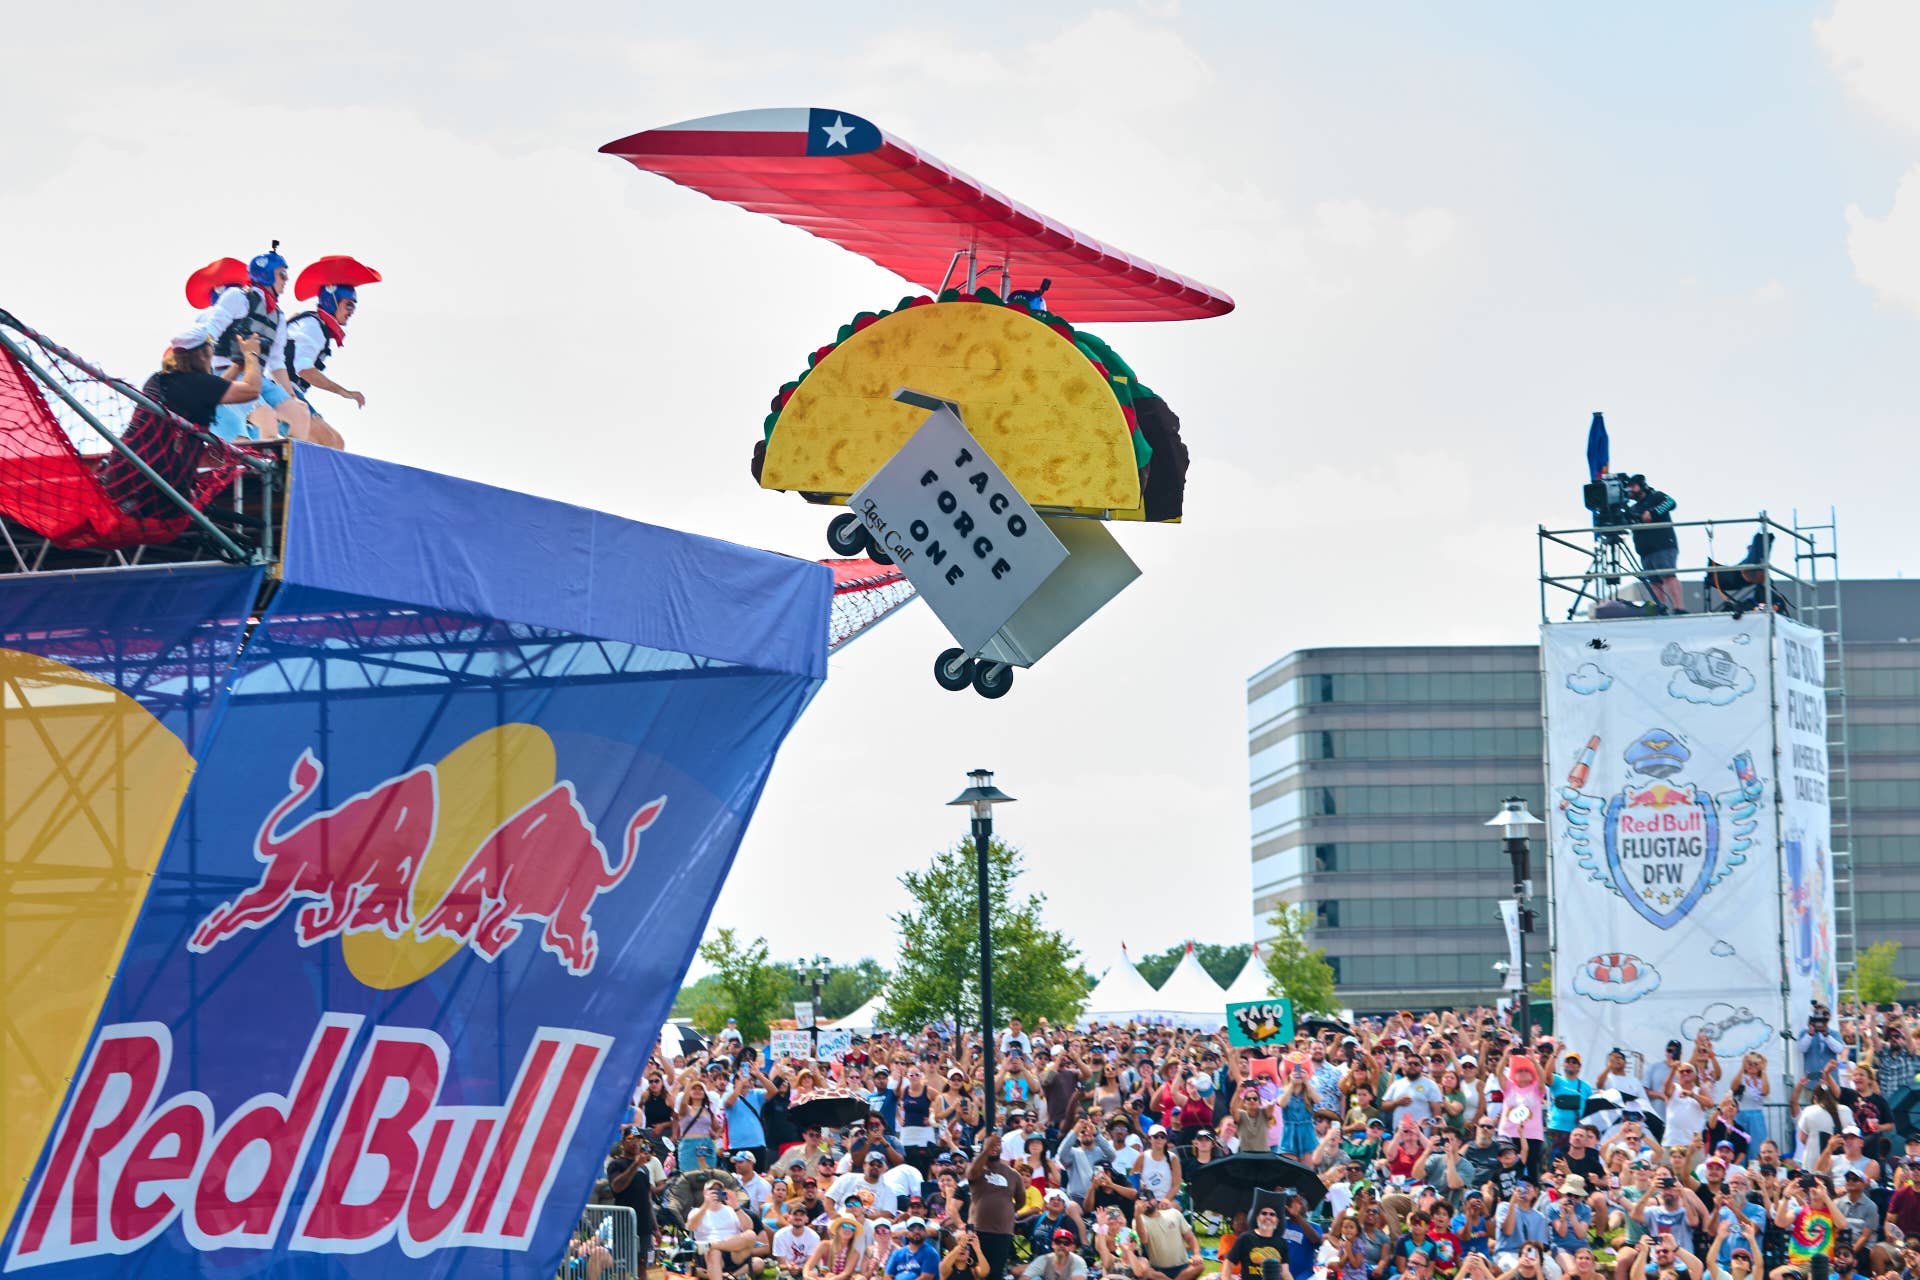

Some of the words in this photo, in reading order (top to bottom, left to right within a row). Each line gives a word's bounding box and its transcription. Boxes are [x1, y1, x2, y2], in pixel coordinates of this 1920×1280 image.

[920, 469, 1011, 580] FORCE
[955, 448, 1027, 538] TACO
[859, 498, 887, 532] Last
[885, 530, 914, 563] Call
[910, 519, 965, 586] ONE
[1621, 813, 1660, 833] Red
[1663, 811, 1701, 832] Bull
[1622, 836, 1702, 859] FLUGTAG
[1643, 863, 1683, 884] DFW
[1233, 1004, 1283, 1022] TACO
[10, 1018, 358, 1265] Red
[294, 1030, 610, 1253] Bull
